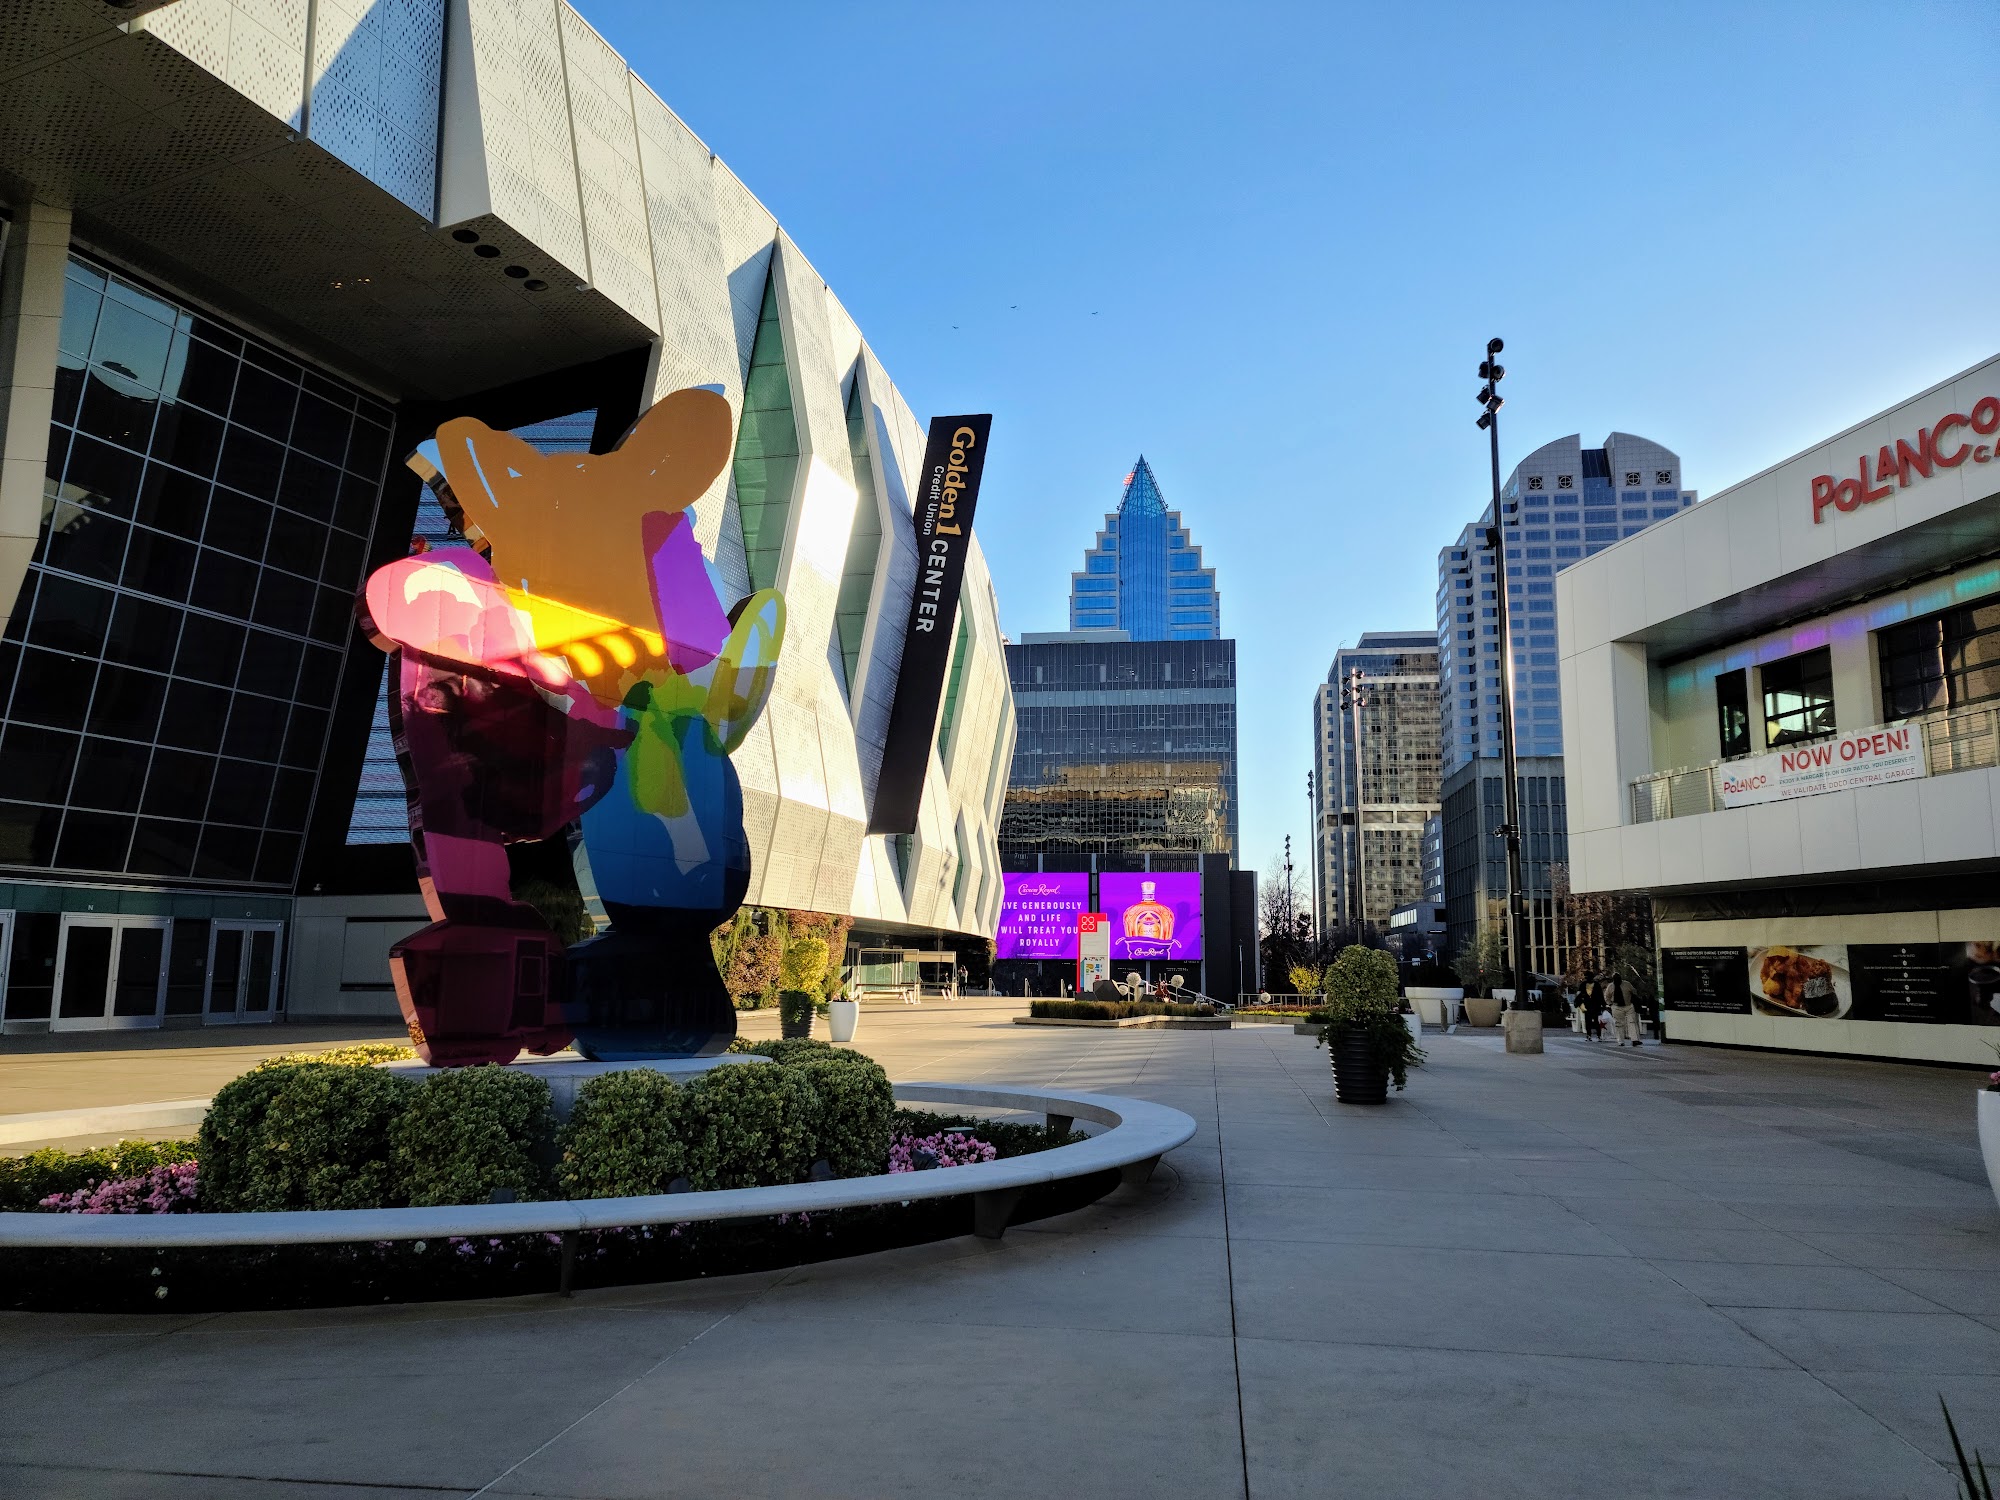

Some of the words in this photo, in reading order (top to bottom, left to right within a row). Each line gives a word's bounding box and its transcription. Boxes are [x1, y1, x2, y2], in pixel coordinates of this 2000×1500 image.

[1812, 396, 2000, 524] POLANCO
[938, 426, 976, 519] Golden
[929, 465, 945, 500] Credit
[922, 502, 939, 536] Union
[935, 521, 962, 537] 1
[915, 539, 949, 633] CENTER
[1781, 744, 1833, 773] NOW
[1839, 728, 1910, 761] OPEN!
[1884, 757, 1908, 766] DESERVE
[1723, 775, 1767, 794] POLANCO
[1794, 783, 1827, 794] VALIDATE
[1828, 779, 1848, 789] DOCO
[1849, 773, 1884, 785] CENTRAL
[1885, 767, 1916, 779] GARAGE
[1018, 883, 1039, 896] Crown
[1033, 883, 1061, 896] Royal
[1003, 901, 1018, 910] IVE
[1022, 901, 1082, 910] GENEROUSLY
[1018, 914, 1036, 922] AND
[1041, 914, 1061, 922] LIFE
[1001, 926, 1023, 934] WILL
[1028, 926, 1056, 934] TREAT
[1060, 926, 1078, 934] YOU
[1020, 938, 1060, 947] ROYALLY
